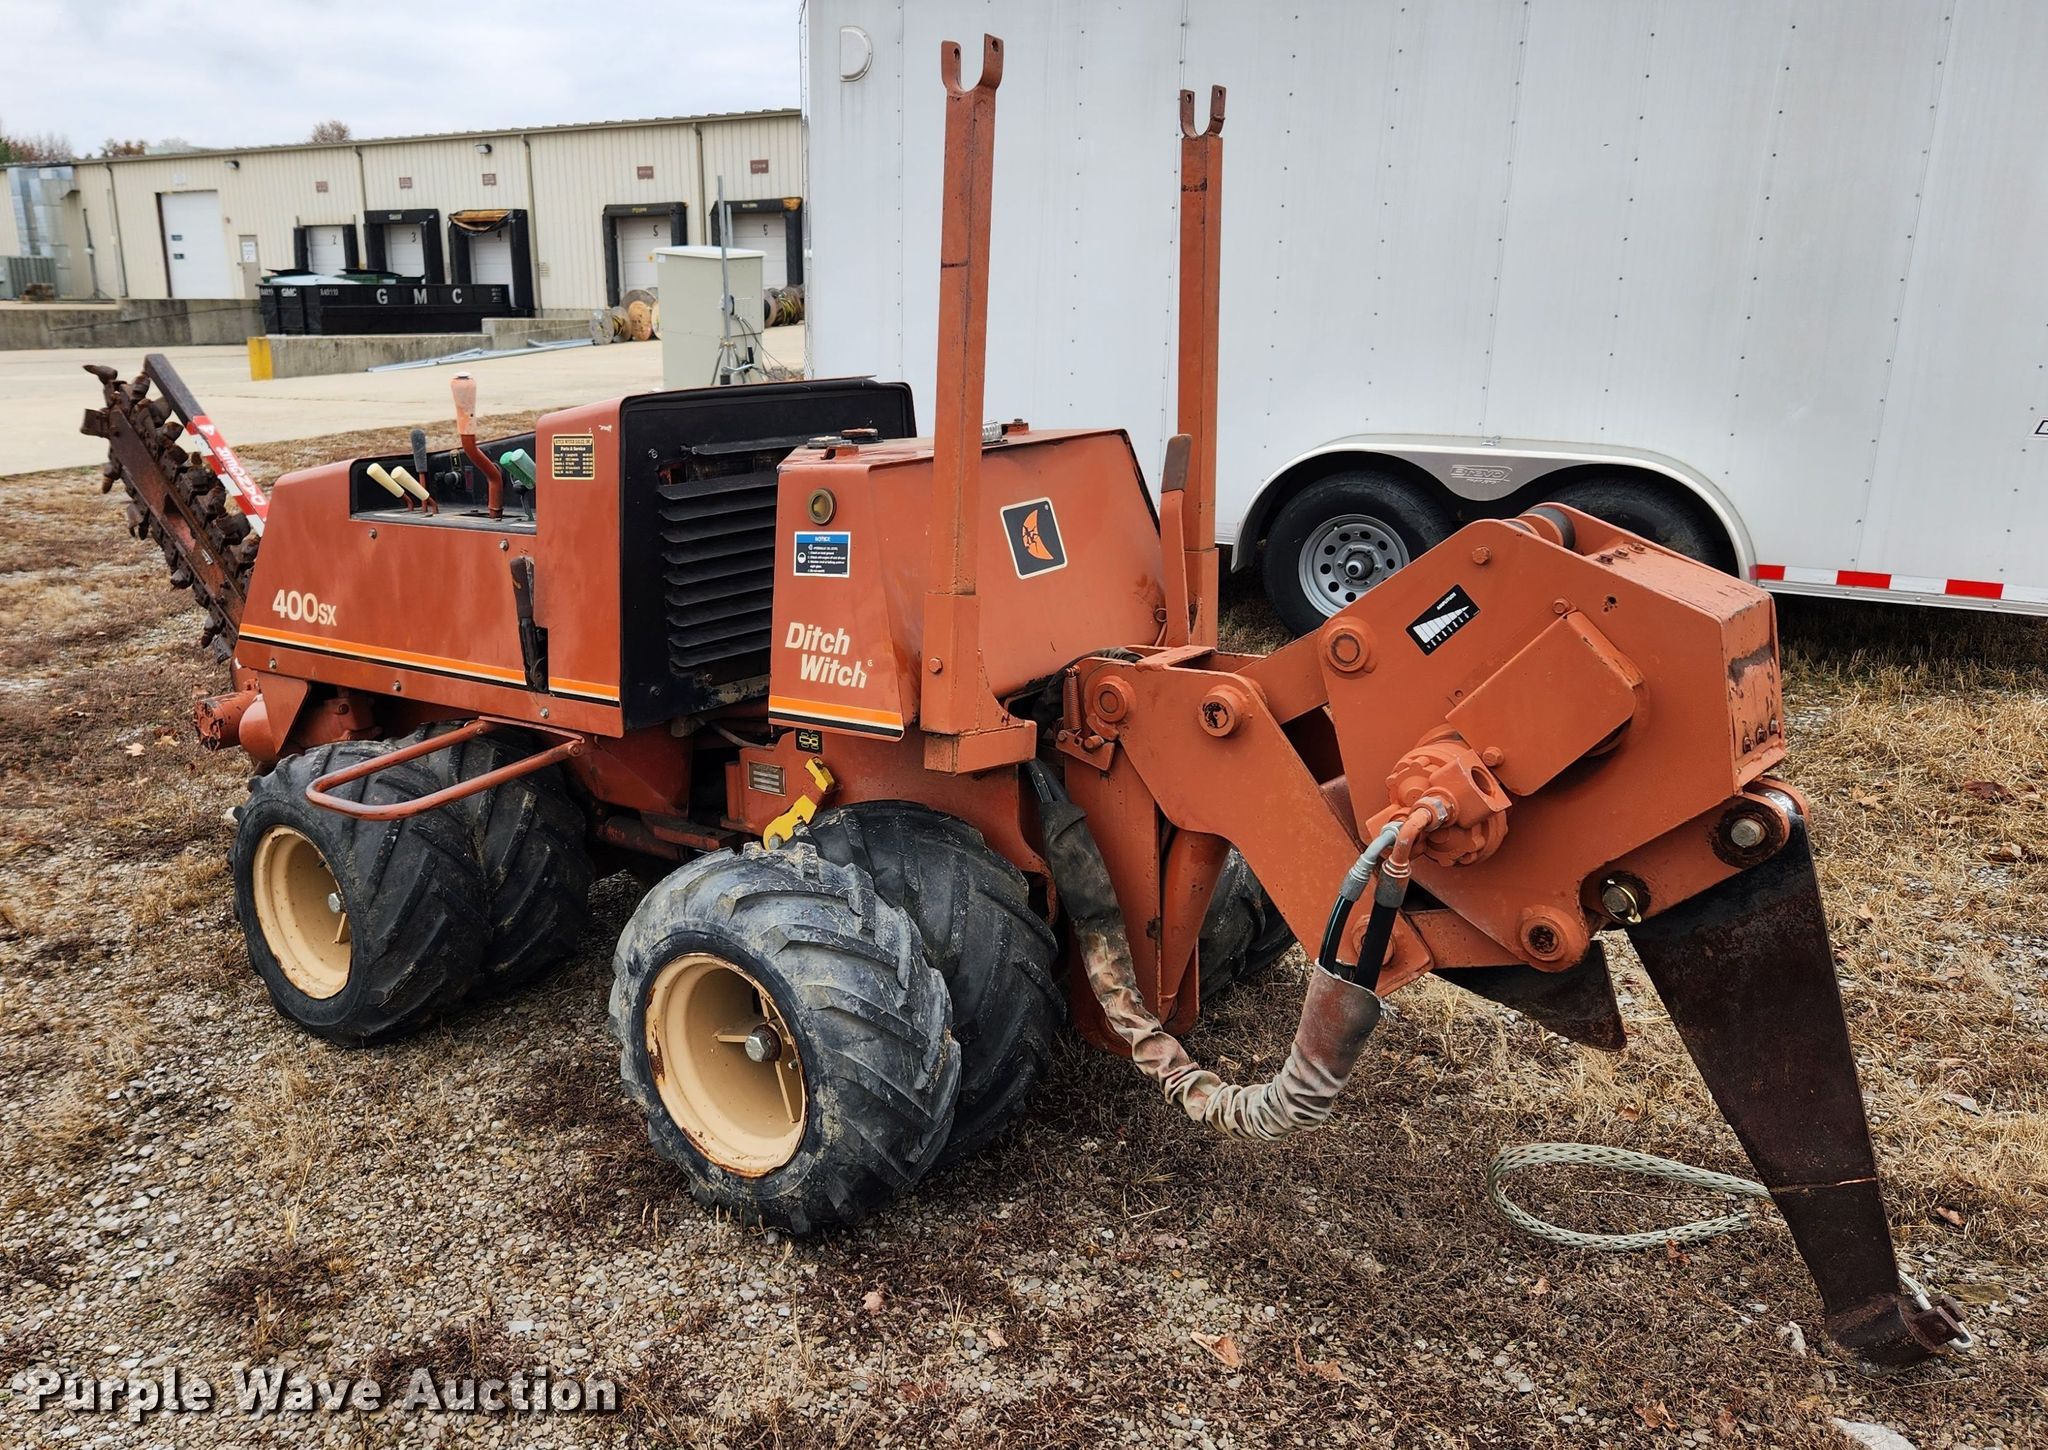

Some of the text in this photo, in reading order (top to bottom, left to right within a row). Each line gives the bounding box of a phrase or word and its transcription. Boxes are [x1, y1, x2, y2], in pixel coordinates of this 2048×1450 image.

[410, 231, 417, 243] 3
[652, 224, 659, 237] 5
[785, 622, 850, 655] Ditch
[800, 653, 867, 689] Witch
